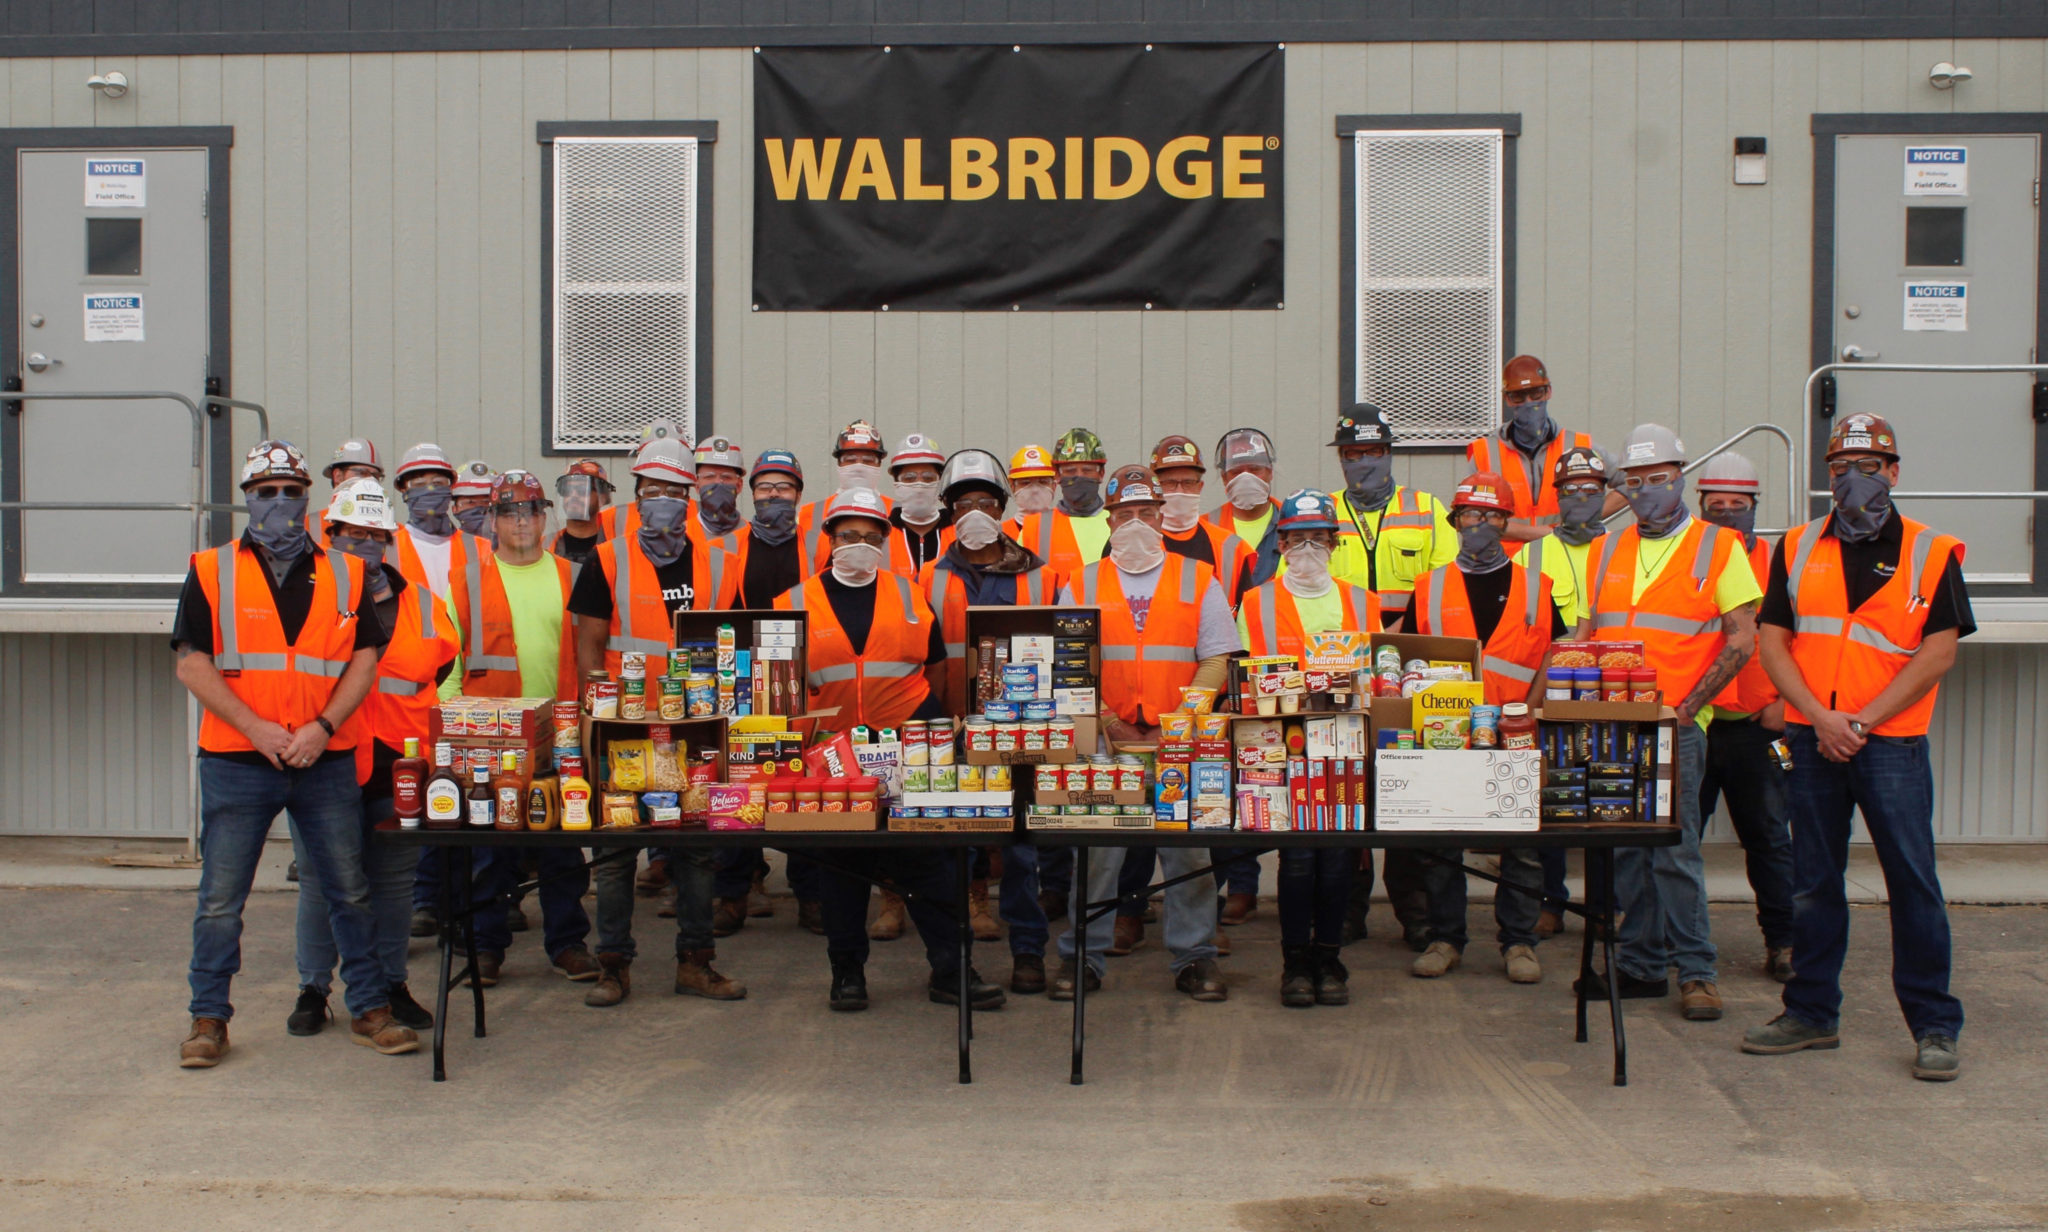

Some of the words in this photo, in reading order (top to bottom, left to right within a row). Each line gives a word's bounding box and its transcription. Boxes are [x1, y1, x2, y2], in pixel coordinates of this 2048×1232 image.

[1913, 151, 1960, 161] NOTICE
[94, 163, 137, 173] NOTICE
[1914, 286, 1958, 297] NOTICE
[93, 298, 133, 308] NOTICE
[359, 506, 383, 515] TESS
[1308, 654, 1356, 665] Buttermilk
[1260, 677, 1283, 688] Snack
[1306, 674, 1328, 683] Snack
[1265, 683, 1283, 692] pack
[1311, 679, 1328, 689] pack
[1421, 693, 1475, 709] Cheerios
[1508, 737, 1532, 747] Prego
[729, 752, 755, 760] KIND
[1239, 749, 1263, 759] Snack
[1244, 755, 1263, 764] pack
[1380, 778, 1409, 790] copy
[711, 793, 742, 807] Deluxe
